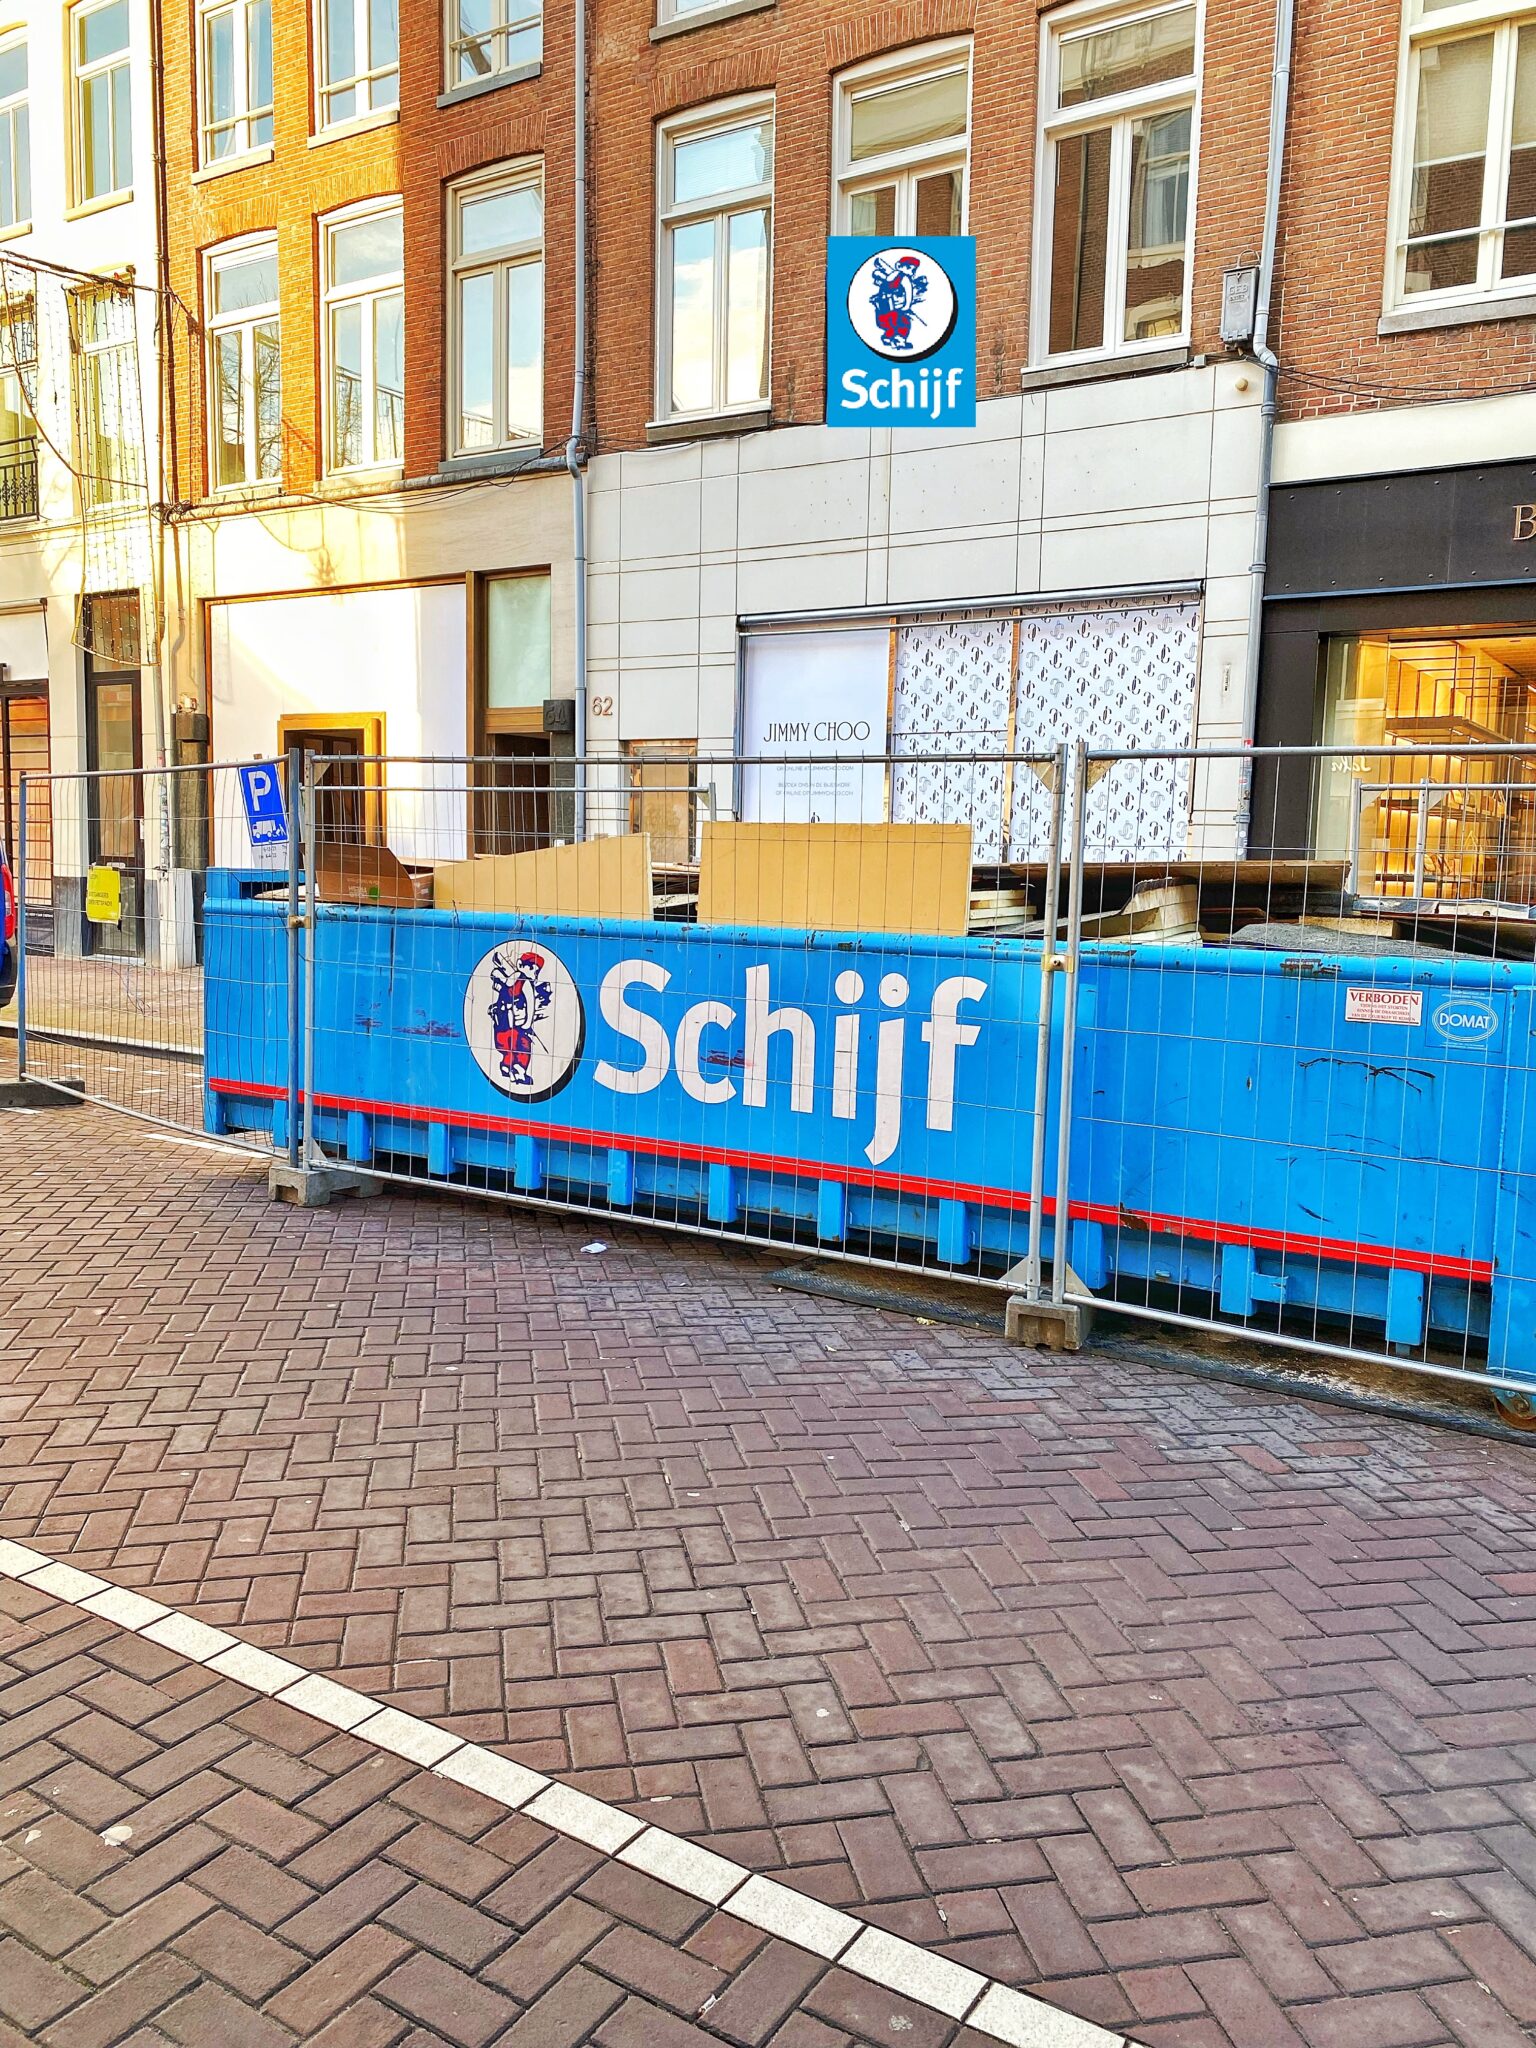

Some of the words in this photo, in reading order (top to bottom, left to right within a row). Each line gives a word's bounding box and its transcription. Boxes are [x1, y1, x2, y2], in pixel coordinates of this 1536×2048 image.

[591, 695, 613, 716] 62
[763, 722, 810, 743] JIMMY
[814, 721, 871, 742] CHOO
[247, 771, 272, 812] P
[1350, 992, 1419, 1005] VERBODEN
[1439, 1013, 1491, 1029] DOMAT
[593, 958, 988, 1166] Schijf
